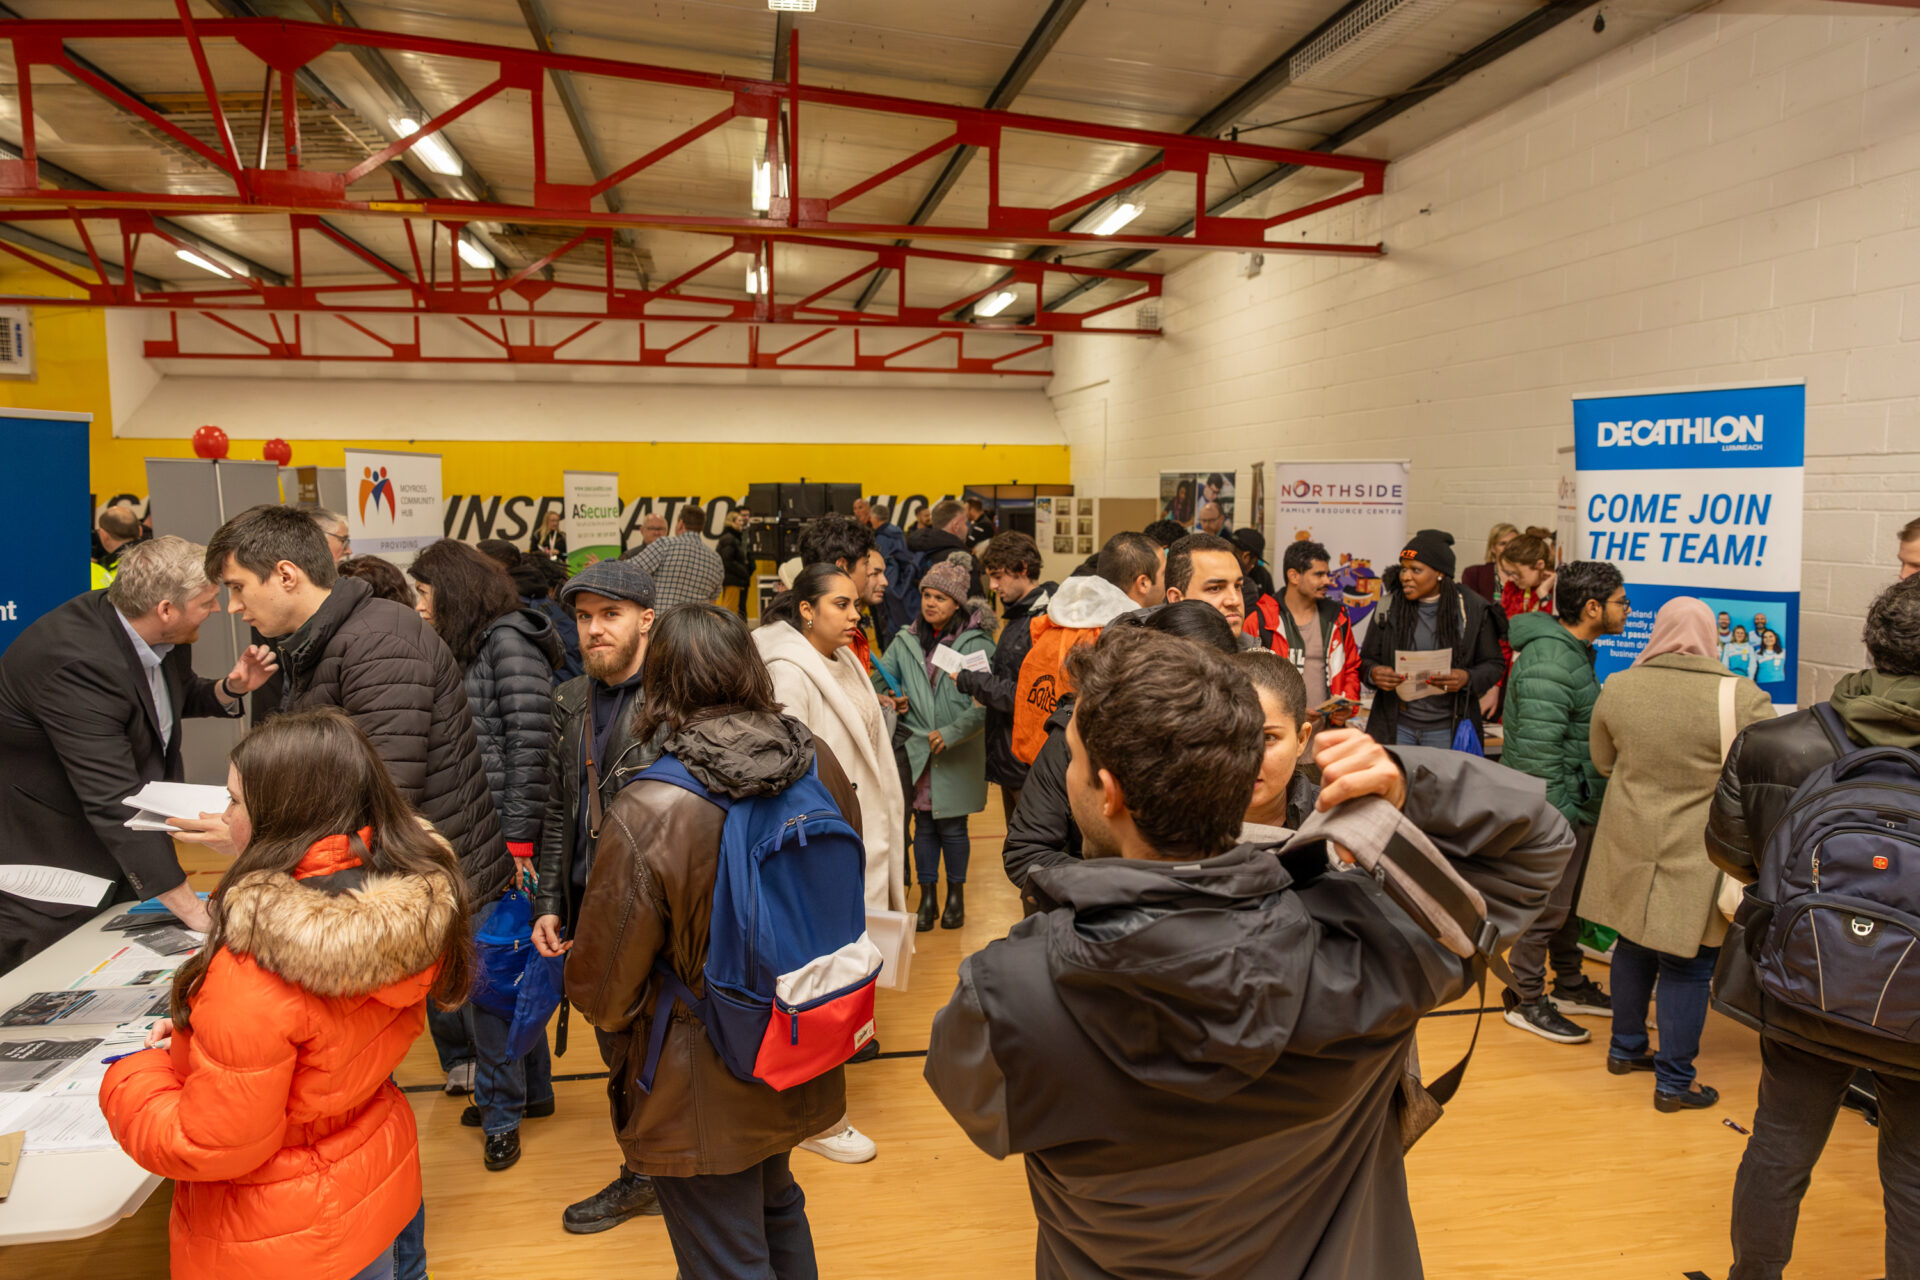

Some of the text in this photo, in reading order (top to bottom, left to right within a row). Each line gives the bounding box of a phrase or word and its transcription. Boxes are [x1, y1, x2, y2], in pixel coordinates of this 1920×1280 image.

[1597, 414, 1764, 447] DECATHLON
[400, 484, 428, 493] MOYROSS
[1281, 480, 1403, 498] NORTHSIDE
[400, 496, 435, 505] COMMUNITY
[401, 508, 413, 517] HUB
[572, 503, 619, 519] ASecure
[1315, 507, 1363, 515] RESOURCE
[1588, 493, 1772, 525] COME JOIN
[380, 540, 418, 550] PROVIDING
[1588, 531, 1768, 567] THE TEAM!
